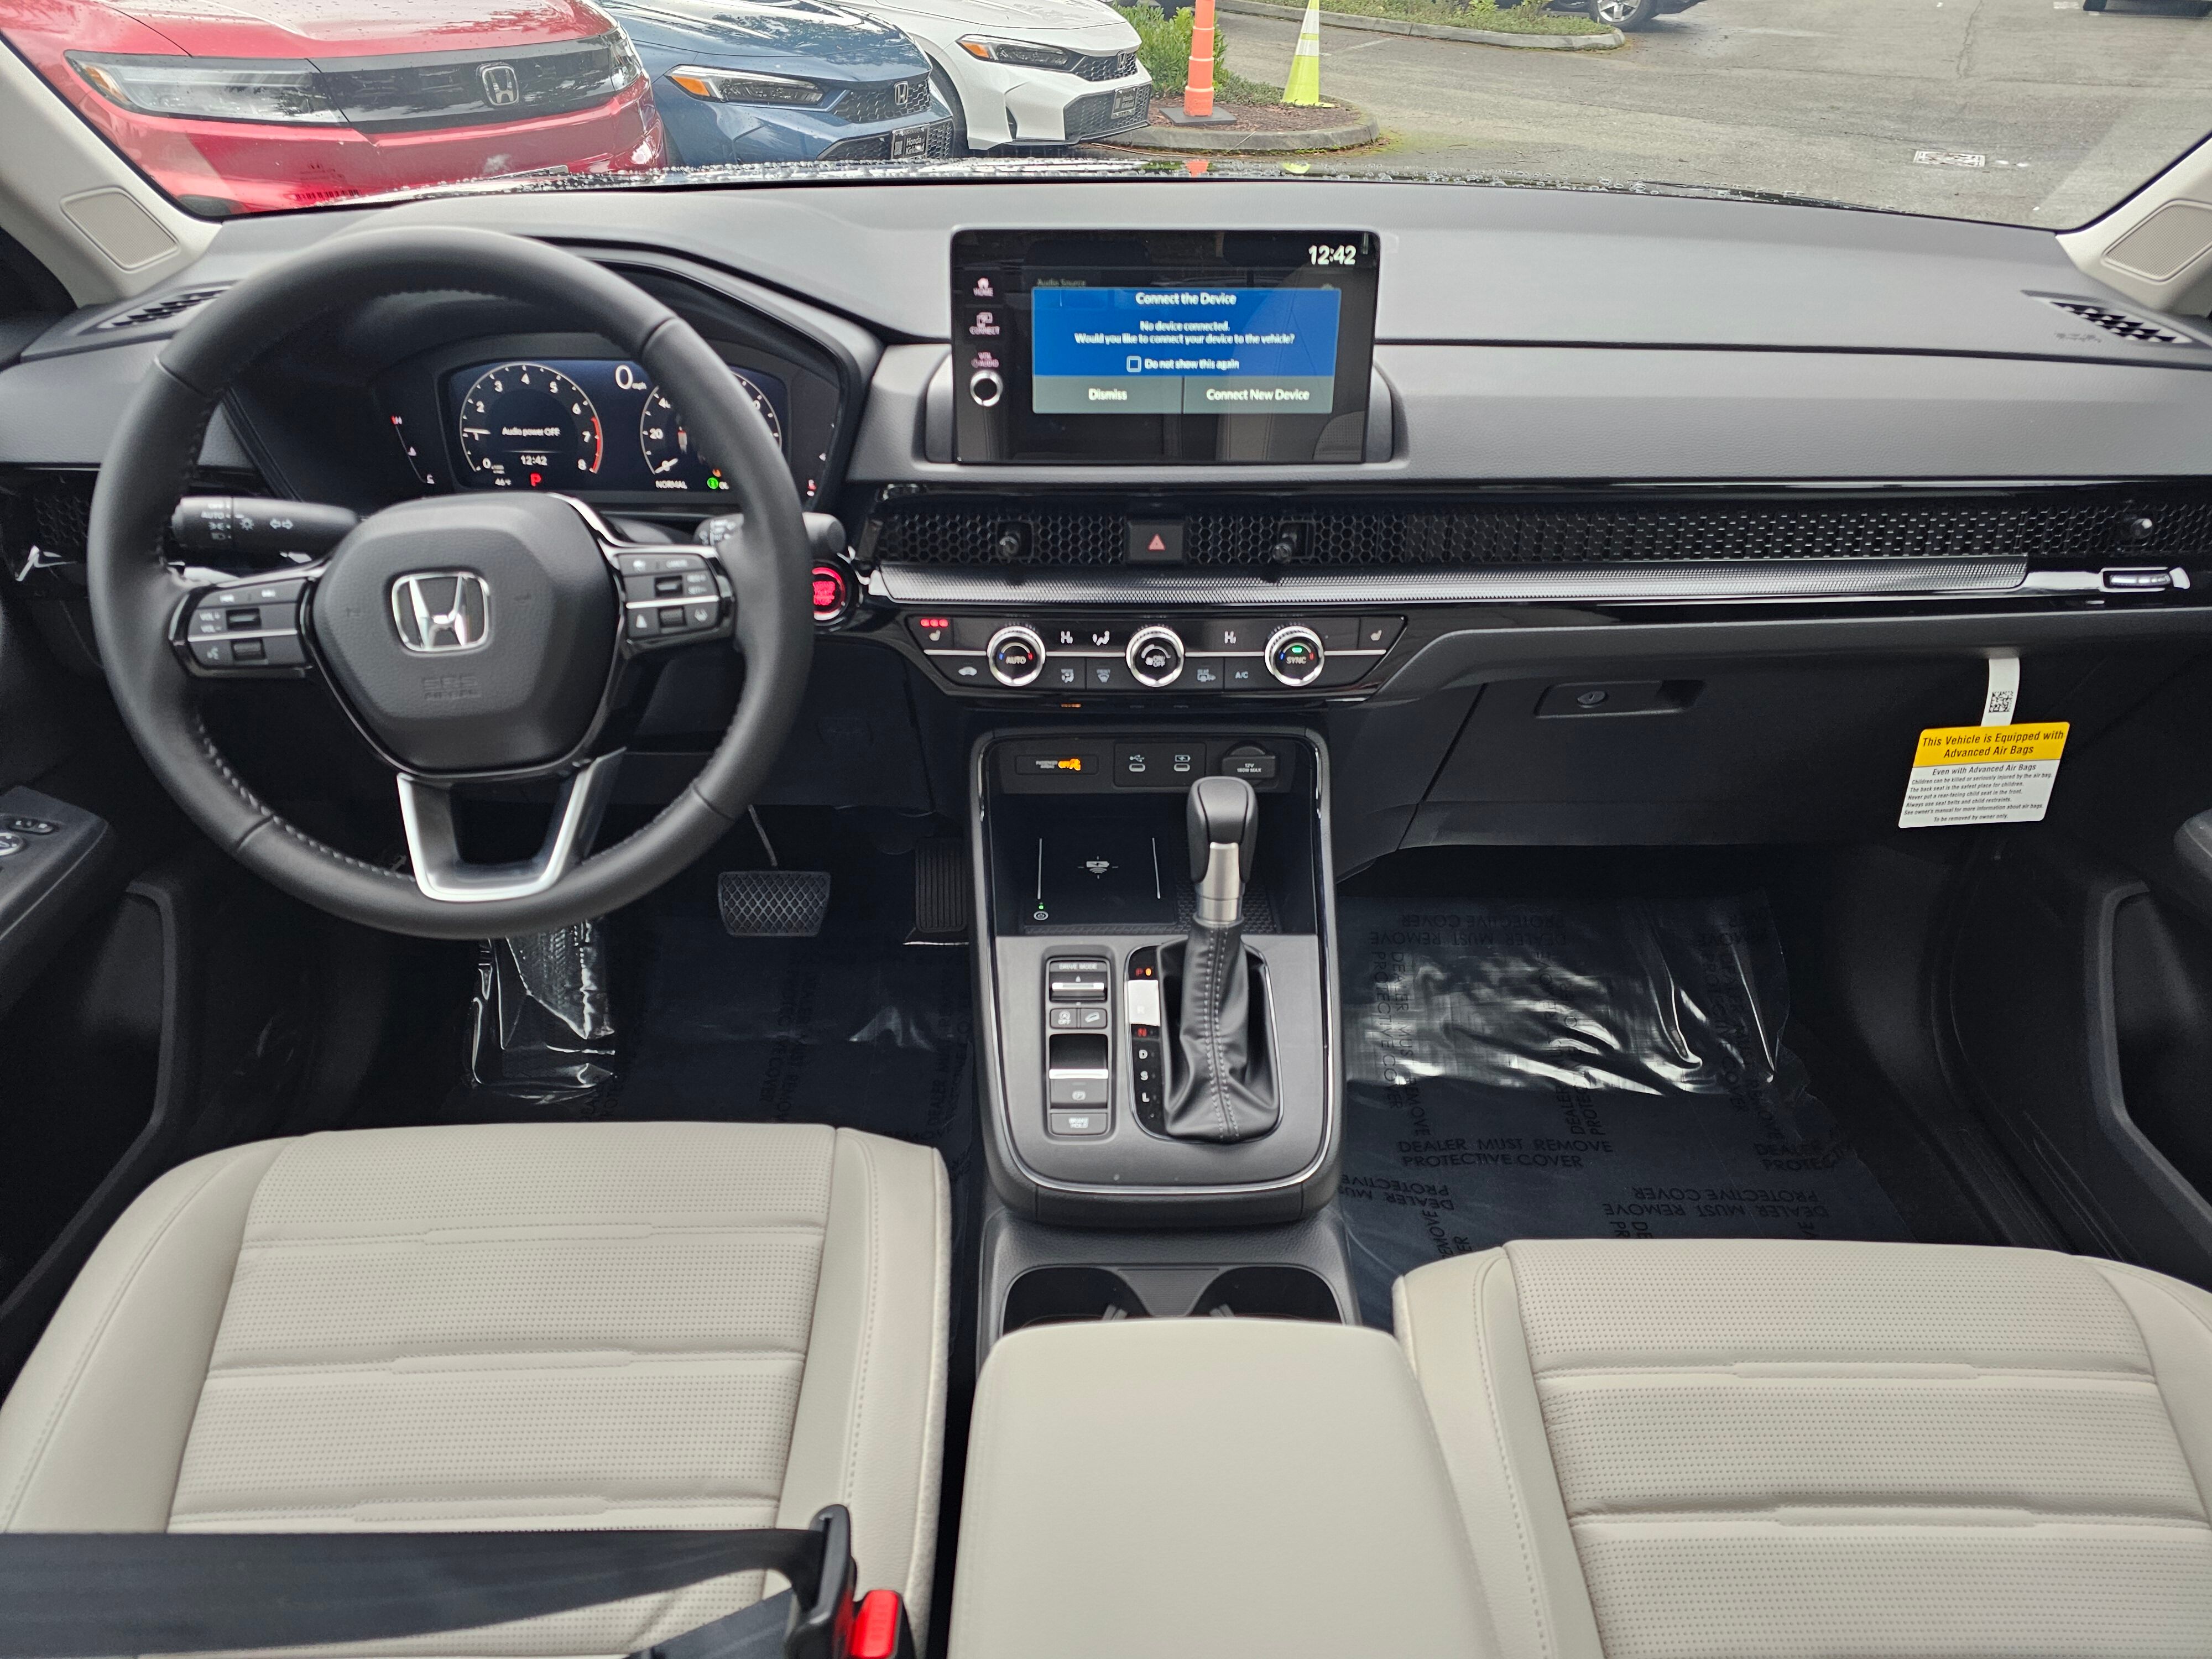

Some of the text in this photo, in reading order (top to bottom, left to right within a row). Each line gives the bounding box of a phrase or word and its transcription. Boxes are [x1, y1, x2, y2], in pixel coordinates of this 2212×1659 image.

[906, 135, 921, 146] Honda
[1308, 245, 1357, 265] 12:42
[1135, 292, 1237, 305] Connect the Device
[1140, 321, 1154, 331] No
[1155, 321, 1183, 331] device
[1074, 333, 1295, 345] Would you like to connect your device to the vehicle?
[1144, 358, 1240, 371] Do not show this again
[521, 373, 530, 385] 4
[615, 364, 634, 389] 0
[494, 380, 503, 392] 3
[550, 381, 558, 393] 5
[1088, 388, 1128, 400] Dismiss
[1206, 388, 1310, 400] Connect New Device
[476, 400, 485, 413] 2
[572, 402, 581, 415] 6
[502, 426, 561, 437] Audio power OFF
[582, 431, 591, 443] 7
[649, 427, 664, 440] 20
[482, 457, 492, 469] 0
[520, 455, 548, 466] 12:42
[577, 458, 587, 471] 8
[530, 473, 542, 487] P
[655, 480, 688, 489] NORMAL
[1005, 656, 1027, 664] AUTO
[1235, 671, 1249, 679] A/C
[1923, 729, 2064, 747] This Vehicle is Equipped with
[1943, 745, 2034, 758] Advanced Air Bags
[1969, 765, 2005, 773] Advanced
[1135, 968, 1144, 977] P
[1136, 1005, 1145, 1014] R
[1138, 1027, 1147, 1037] N
[1139, 1049, 1148, 1059] D
[1140, 1071, 1149, 1081] S
[1141, 1092, 1150, 1103] L
[1397, 1138, 1613, 1154] DEALER MUST REMOVE
[1402, 1153, 1584, 1168] PROTECTIVE COVER
[1340, 1173, 1450, 1196] PROTECTIVE
[1631, 1186, 1819, 1203] PROTECTIVE COVER
[1383, 1192, 1455, 1212] DEALER
[1601, 1202, 1830, 1218] DEALER MUST REMOVE
